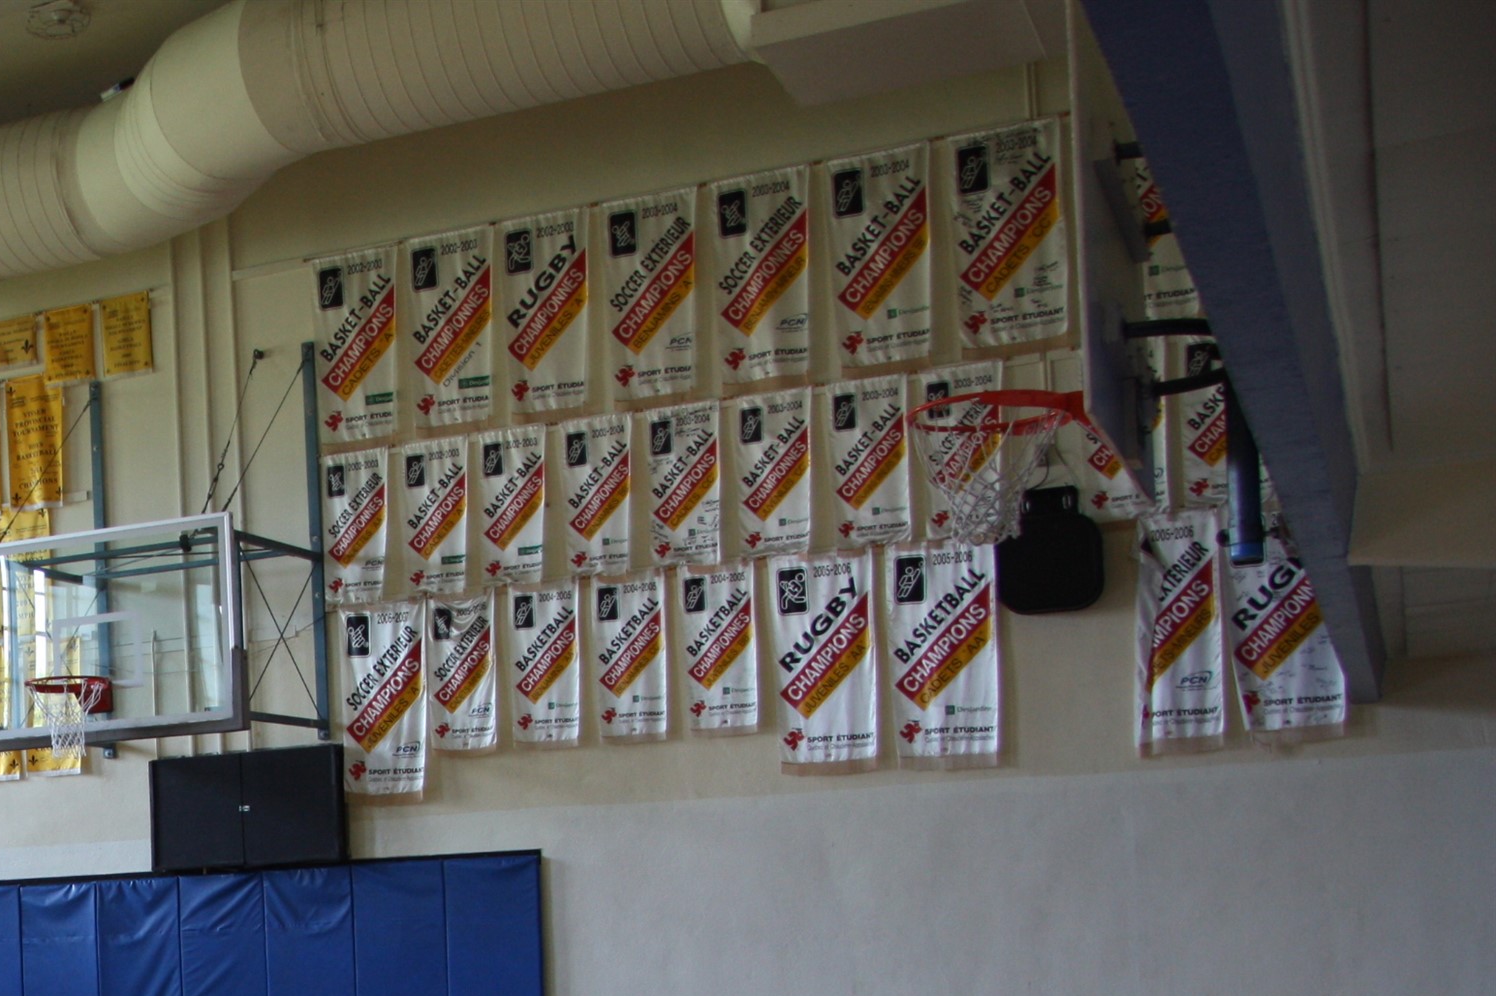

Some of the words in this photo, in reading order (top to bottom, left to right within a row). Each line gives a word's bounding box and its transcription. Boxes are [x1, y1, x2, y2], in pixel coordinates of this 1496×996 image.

[835, 175, 922, 277] BASKET-BALL
[958, 150, 1052, 256] BASKET-BALL
[969, 186, 1053, 284] CHAMPIONS
[506, 233, 578, 330] RUGBY
[718, 251, 757, 296] SOCCER
[728, 229, 805, 321] CHAMPIONNES
[845, 208, 924, 303] CHAMPIONS
[985, 243, 1030, 295] CADETS
[319, 273, 392, 364] BASKET-BALL
[412, 254, 487, 345] BASKET-BALL
[514, 268, 584, 355] CHAMPIONNES
[609, 270, 648, 313] SOCCER
[619, 250, 692, 339] CHAMPIONS
[328, 303, 393, 387] CHAMPIONS
[422, 284, 490, 369] CHAMPIONNES
[530, 311, 572, 366] JUVENILES
[342, 347, 380, 397] CADETS
[443, 349, 476, 388] Division
[651, 428, 714, 500] BASKET-BALL
[741, 415, 806, 489] BASKET-BALL
[834, 402, 902, 477] BASKET-BALL
[842, 428, 902, 498] CHAMPIONS
[407, 462, 464, 531] BASKET-BALL
[483, 451, 543, 520] BASKET-BALL
[489, 475, 543, 540] CHAMPIONNES
[567, 439, 628, 510] BASKET-BALL
[575, 464, 629, 529] CHAMPIONNES
[659, 453, 716, 519] CHAMPIONS
[749, 440, 807, 509] CHAMPIONNES
[333, 495, 384, 558] CHAMPIONNES
[413, 486, 465, 549] CHAMPIONS
[514, 605, 574, 673] BASKETBALL
[598, 596, 659, 667] BASKETBALL
[685, 586, 748, 658] BASKETBALL
[693, 612, 751, 679] CHAMPIONNES
[778, 576, 858, 674] RUGBY
[892, 567, 986, 665] BASKETBALL
[903, 603, 987, 693] CHAMPIONS
[1262, 612, 1321, 676] JUVENILES
[439, 640, 491, 702] CHAMPIONS
[521, 629, 575, 692] CHAMPIONS
[605, 622, 660, 686] CHAMPIONNES
[787, 613, 866, 701] CHAMPIONS
[805, 661, 851, 713] JUVENILES
[920, 657, 963, 705] CADETS
[346, 673, 379, 712] SOCCER
[353, 657, 420, 738] CHAMPIONS
[1264, 697, 1293, 707] SPORT
[807, 734, 834, 743] SPORT
[924, 726, 950, 736] SPORT
